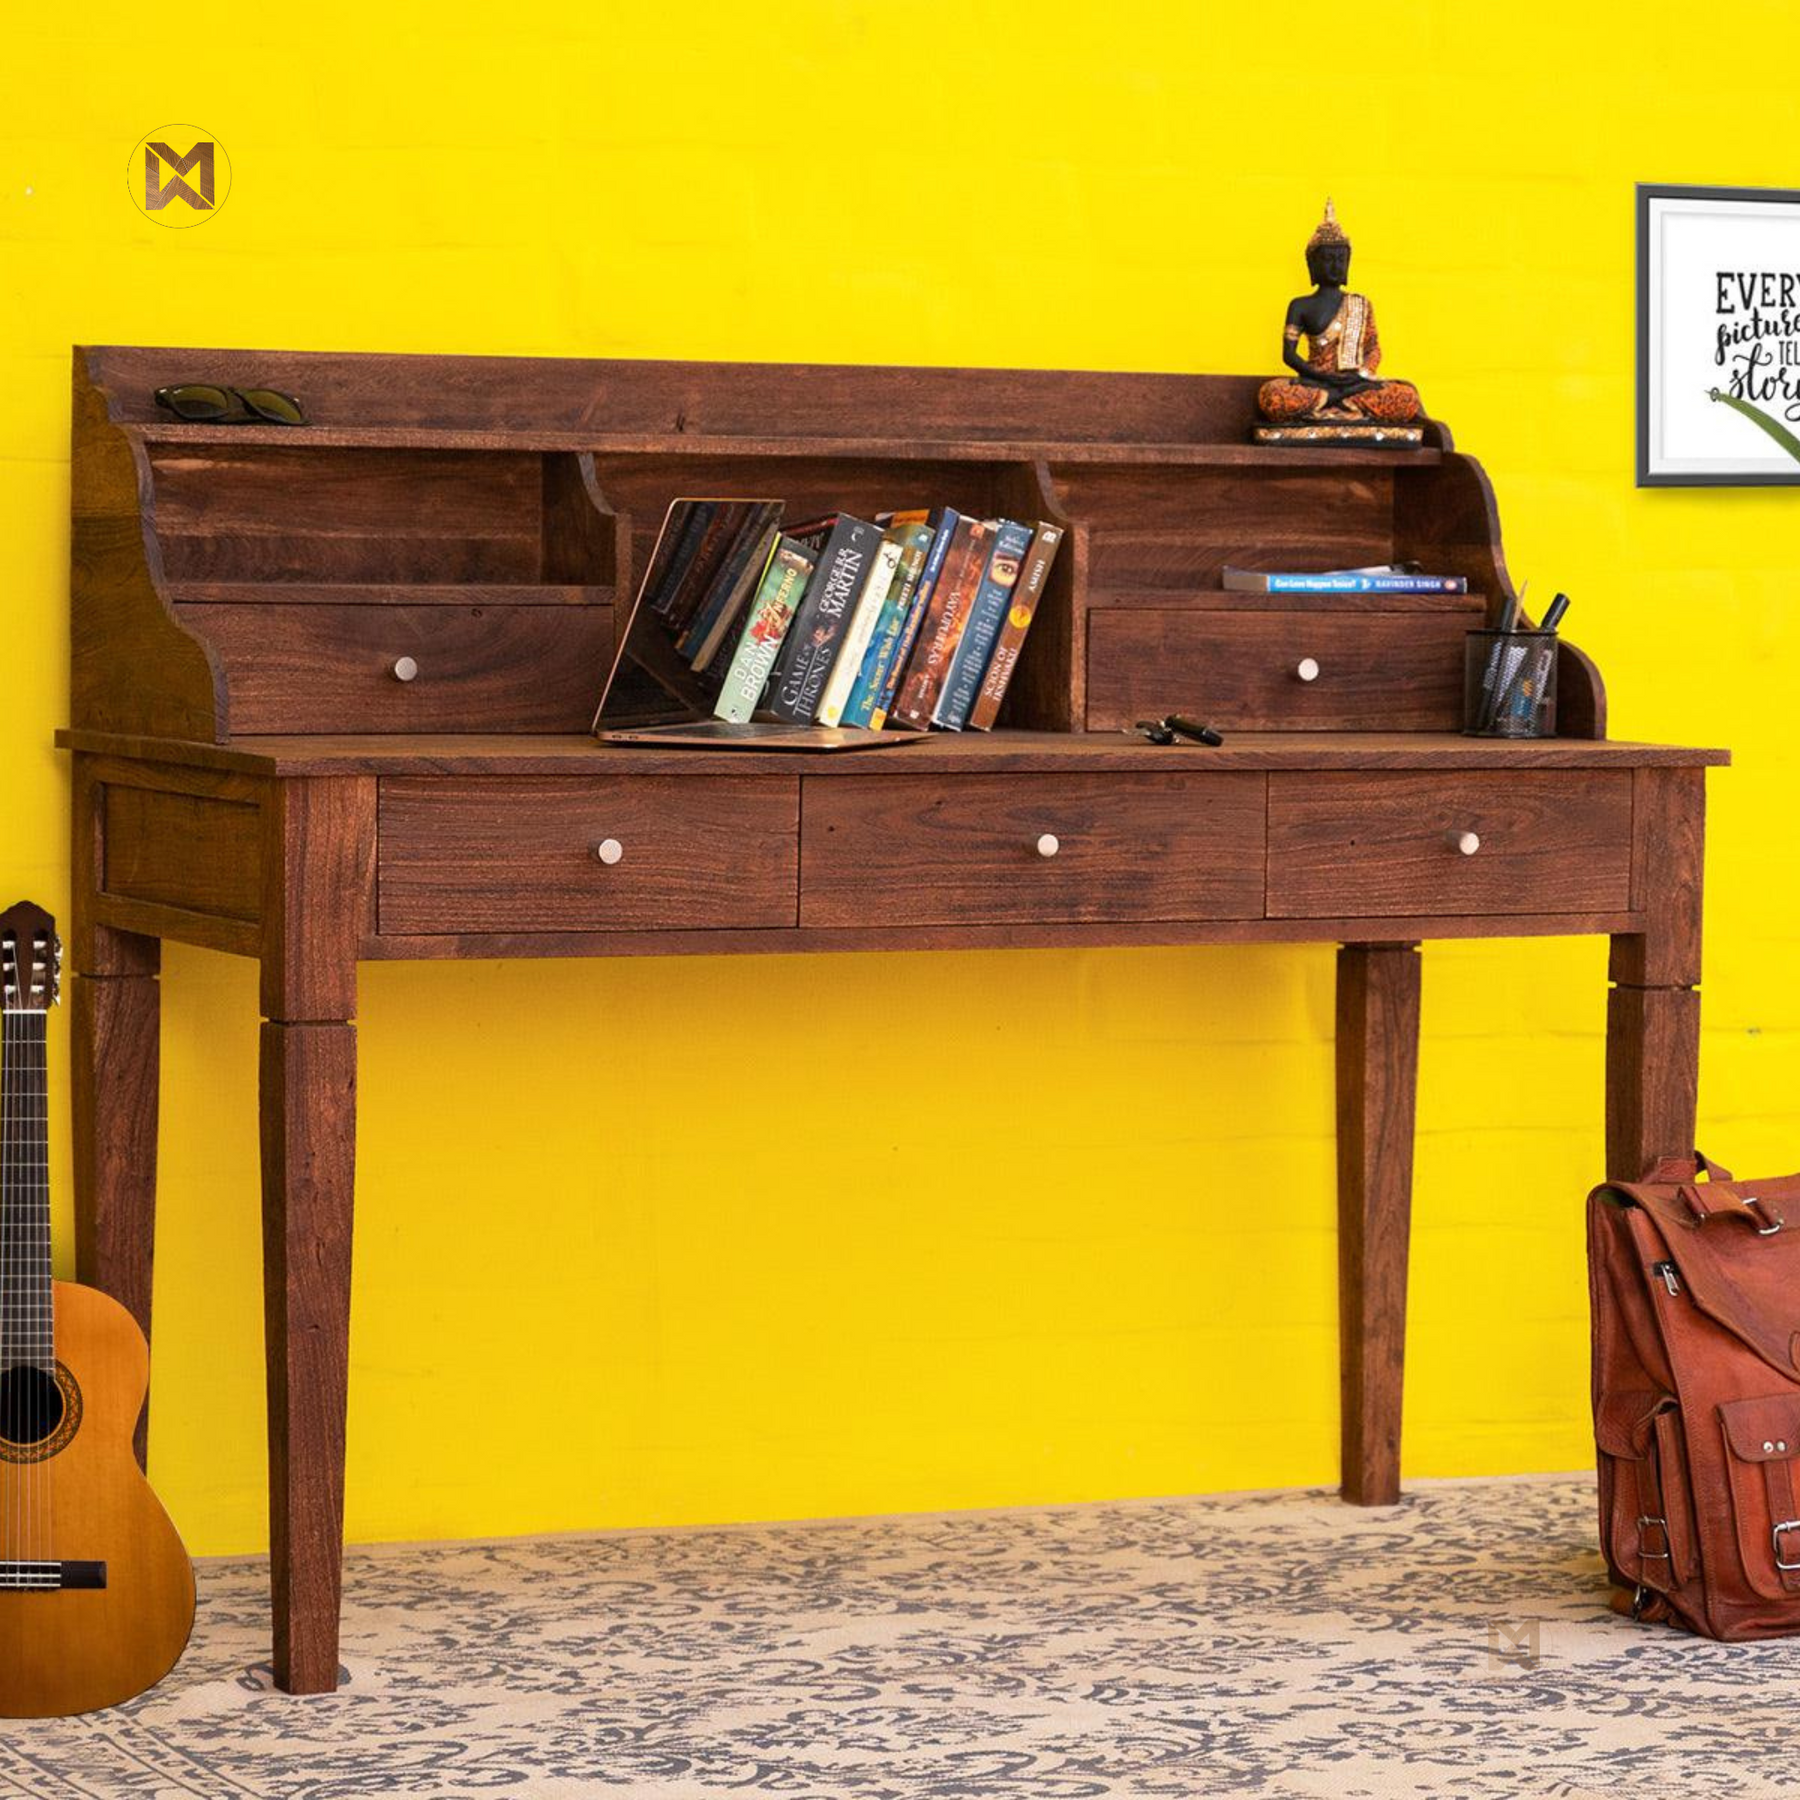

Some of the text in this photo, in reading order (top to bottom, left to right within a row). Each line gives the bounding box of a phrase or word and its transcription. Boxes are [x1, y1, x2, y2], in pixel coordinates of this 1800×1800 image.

[1716, 272, 1800, 314] EVER
[766, 567, 798, 629] INFERNO
[827, 550, 863, 618] MARTIN
[1028, 559, 1045, 591] AMISH
[928, 591, 961, 665] VAYUPUTRAS
[735, 641, 757, 680] DAN
[740, 635, 779, 701] BROWN
[783, 655, 810, 705] GAME
[793, 647, 832, 717] THRONES
[985, 661, 1001, 696] SCION
[861, 695, 874, 710] The
